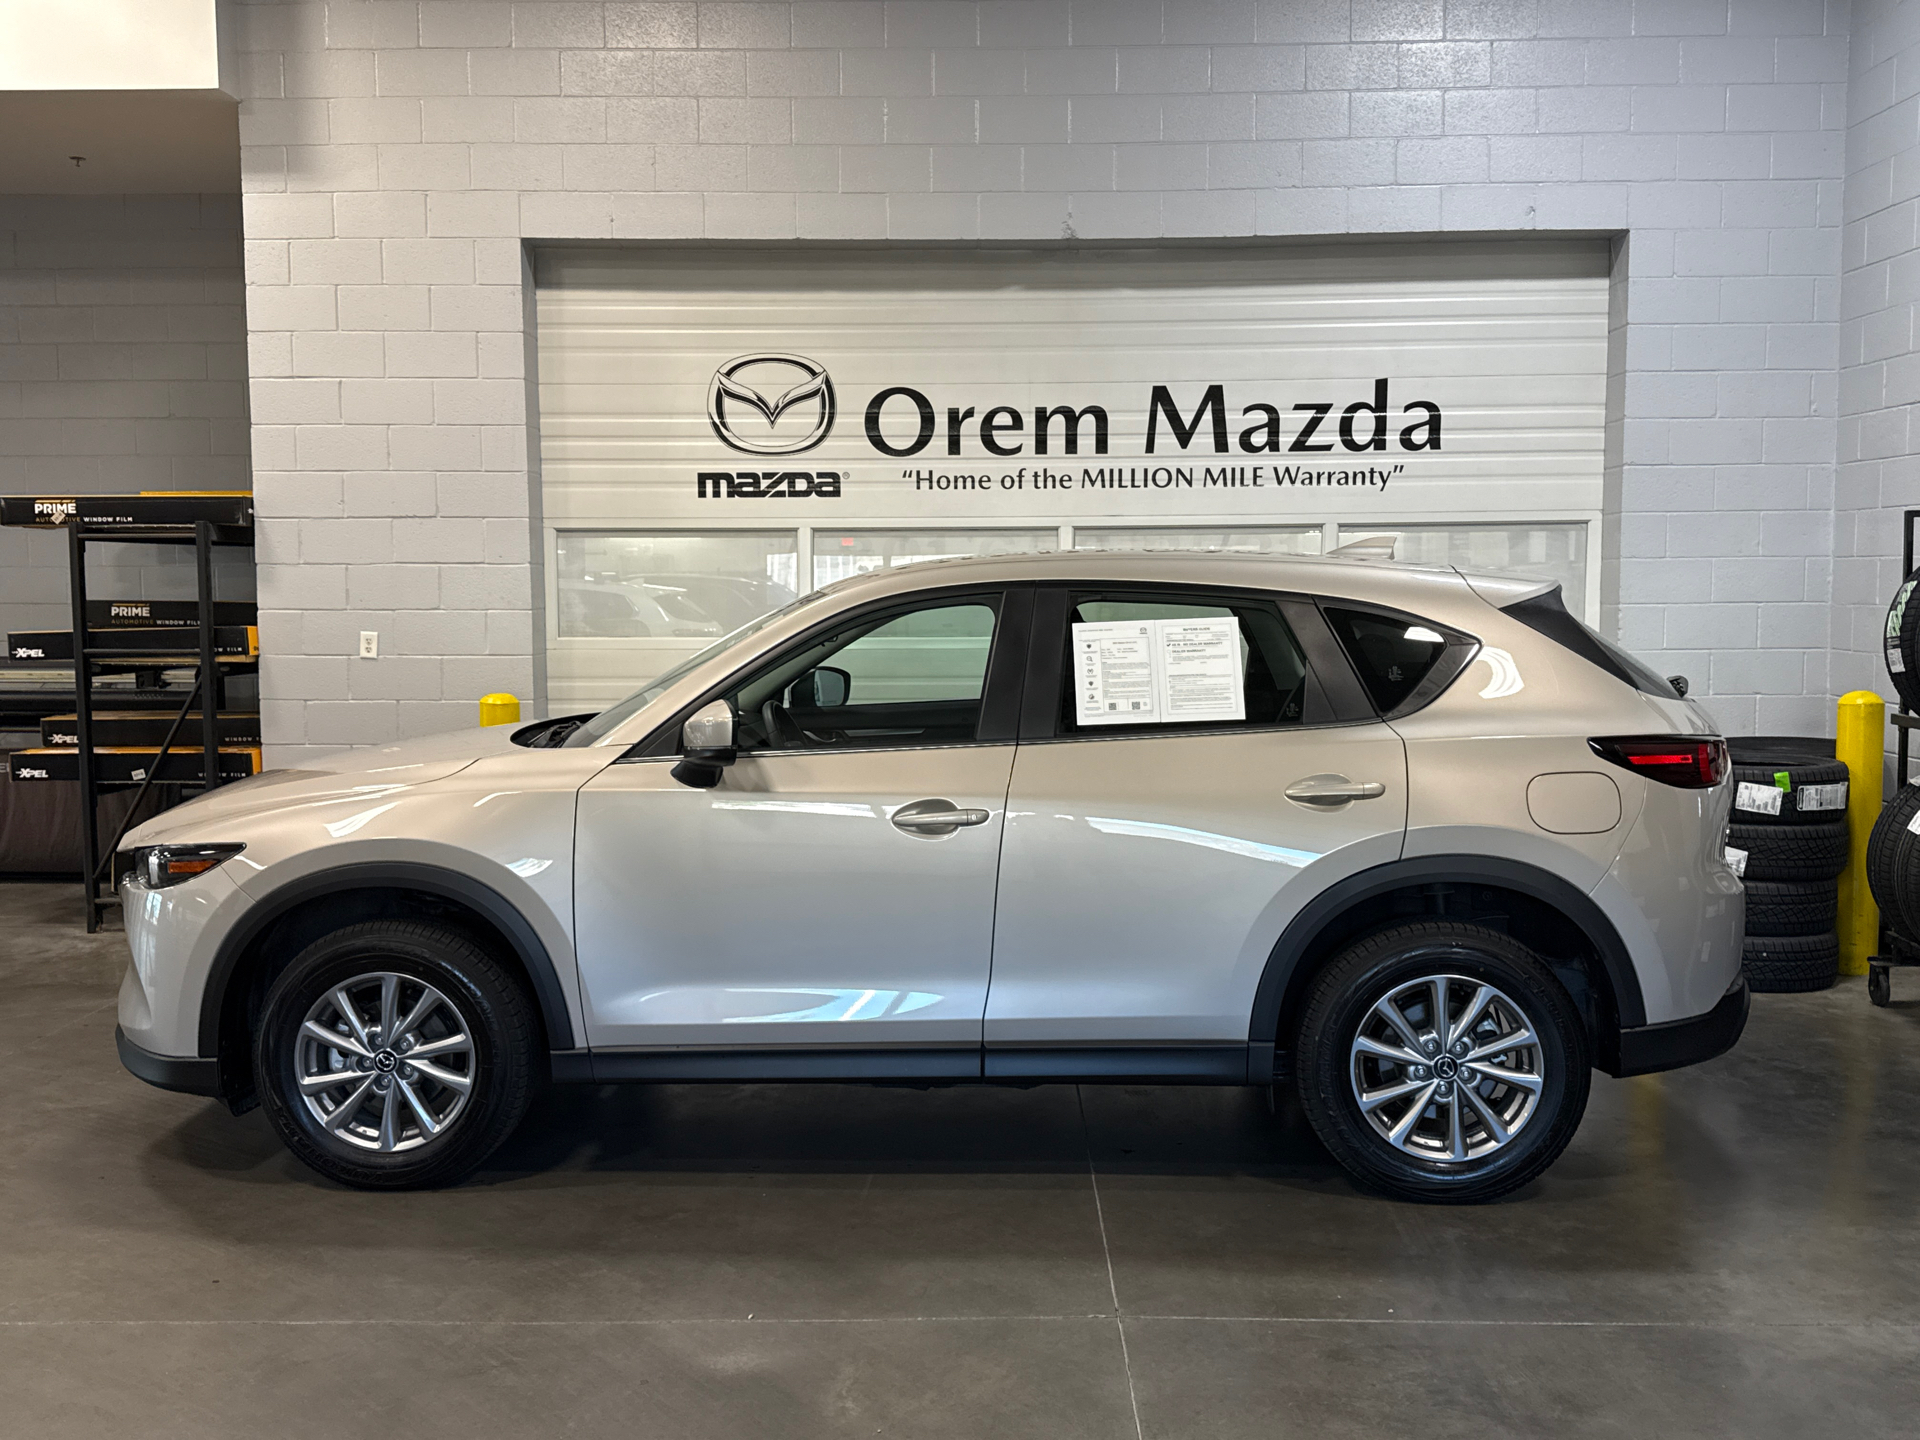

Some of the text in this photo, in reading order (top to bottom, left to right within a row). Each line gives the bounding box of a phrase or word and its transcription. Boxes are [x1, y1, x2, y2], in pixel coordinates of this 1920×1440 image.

[864, 378, 1442, 458] Orem Mazda
[1000, 468, 1027, 490] of
[1033, 468, 1073, 489] the
[1081, 468, 1193, 489] MILLION
[1203, 466, 1264, 488] MILE
[34, 503, 77, 514] PRIME
[111, 606, 150, 617] PRIME
[16, 648, 45, 658] XPEL
[52, 734, 79, 743] XPEL
[19, 768, 49, 778] XPEL
